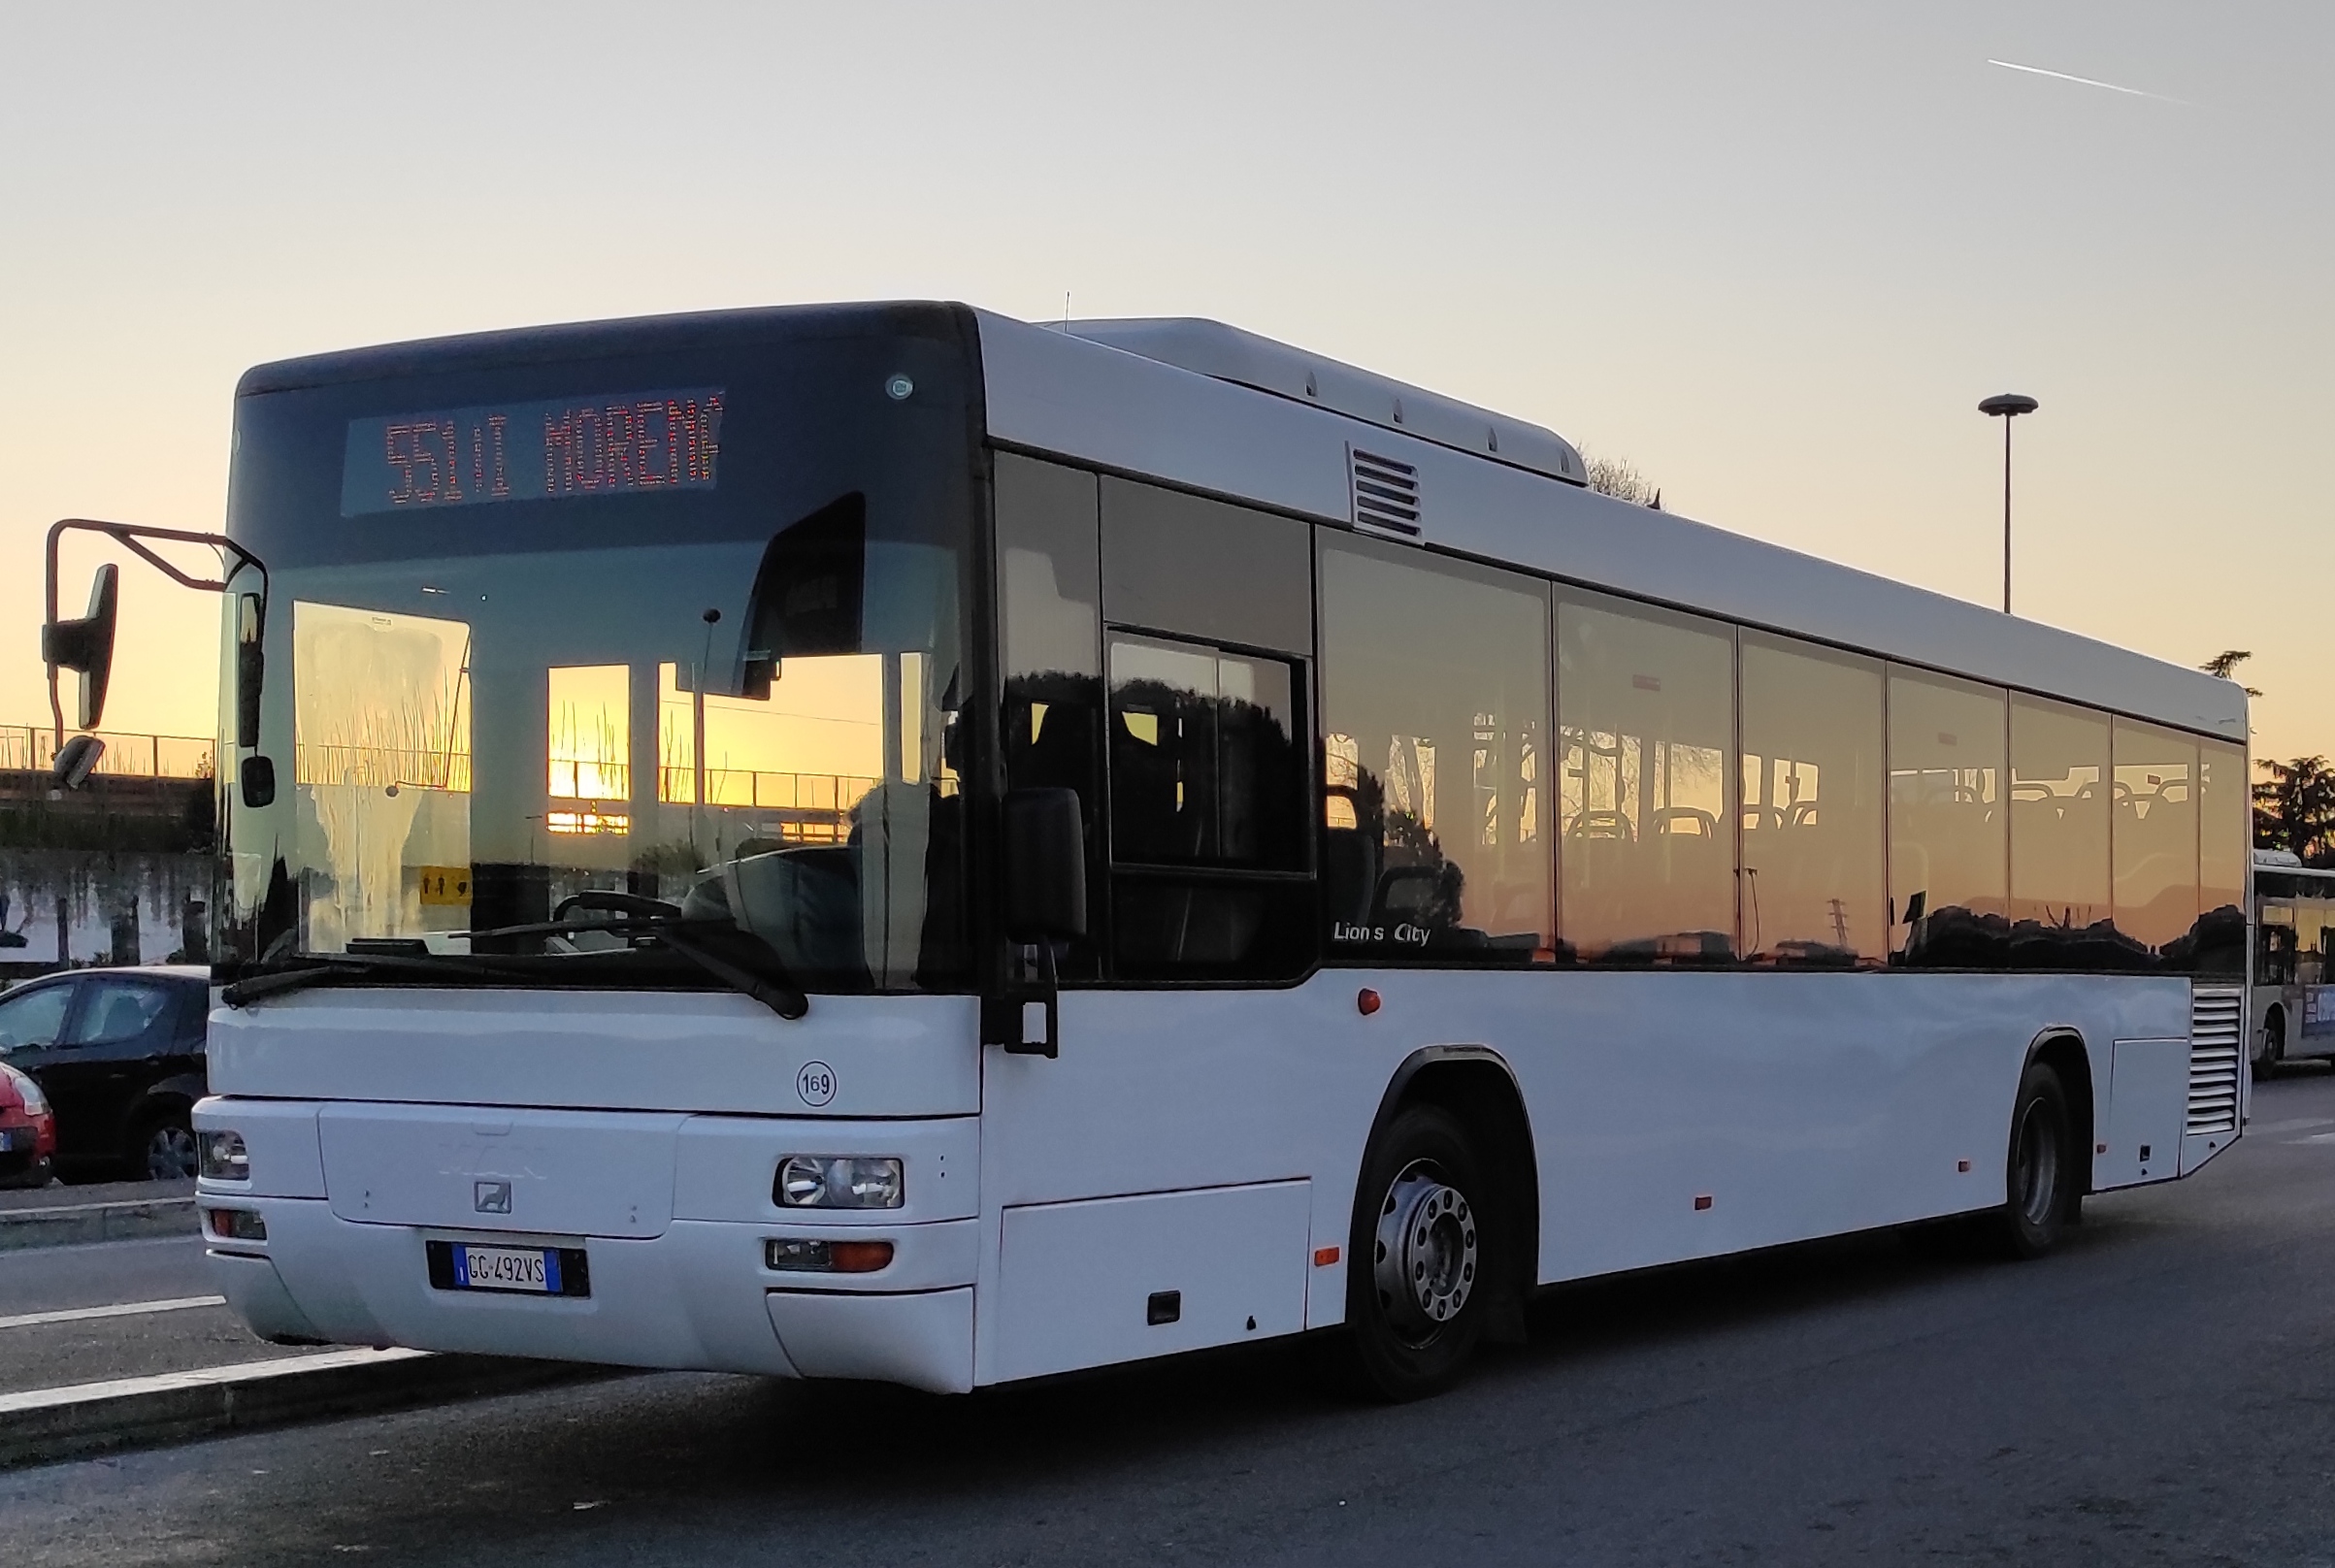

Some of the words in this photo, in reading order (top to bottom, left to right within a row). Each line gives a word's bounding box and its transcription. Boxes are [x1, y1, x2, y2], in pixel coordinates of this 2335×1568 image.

[386, 420, 463, 504] 551
[1394, 923, 1431, 947] City
[803, 1073, 830, 1095] 169
